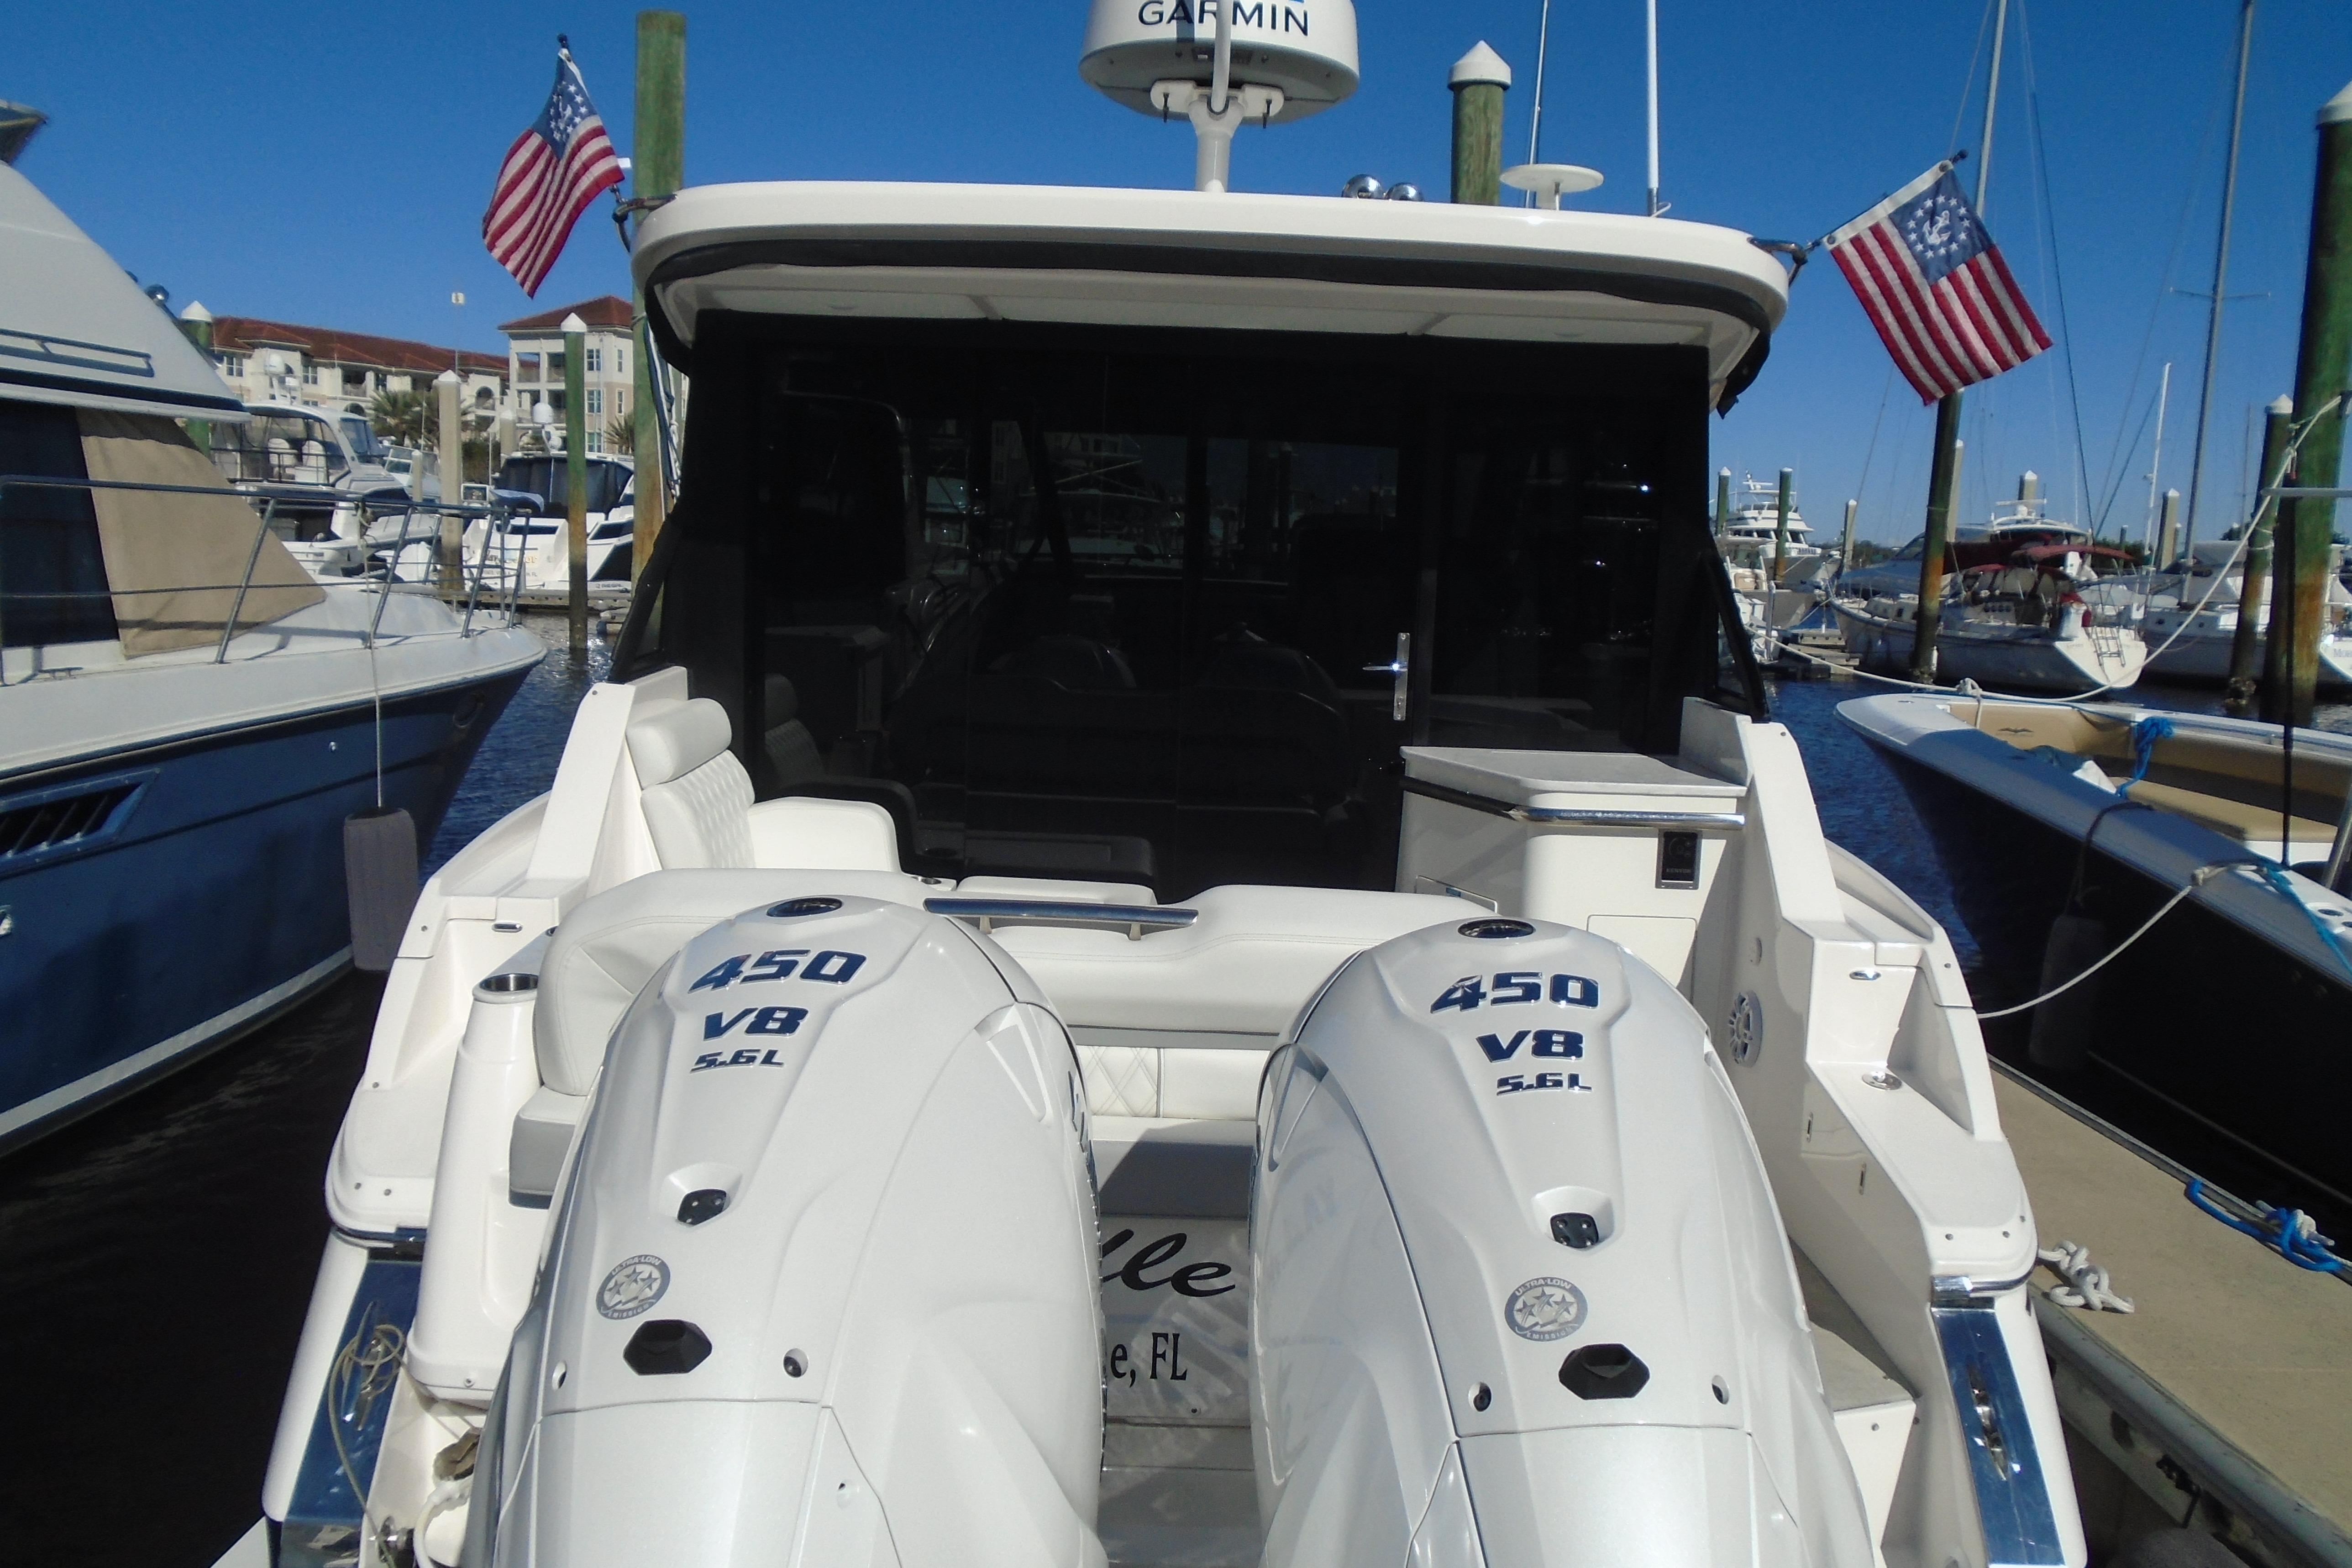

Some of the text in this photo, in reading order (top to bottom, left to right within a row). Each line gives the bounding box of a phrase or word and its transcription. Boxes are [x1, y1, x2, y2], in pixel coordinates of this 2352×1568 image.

[1138, 0, 1308, 36] GARMIN
[688, 949, 867, 994] 450
[1430, 971, 1599, 1014] 450
[703, 1006, 808, 1041] V8
[690, 1049, 784, 1074] 5.6L
[1475, 1029, 1584, 1063] V8
[1496, 1072, 1592, 1096] 5.6L
[1150, 1332, 1187, 1380] FL
